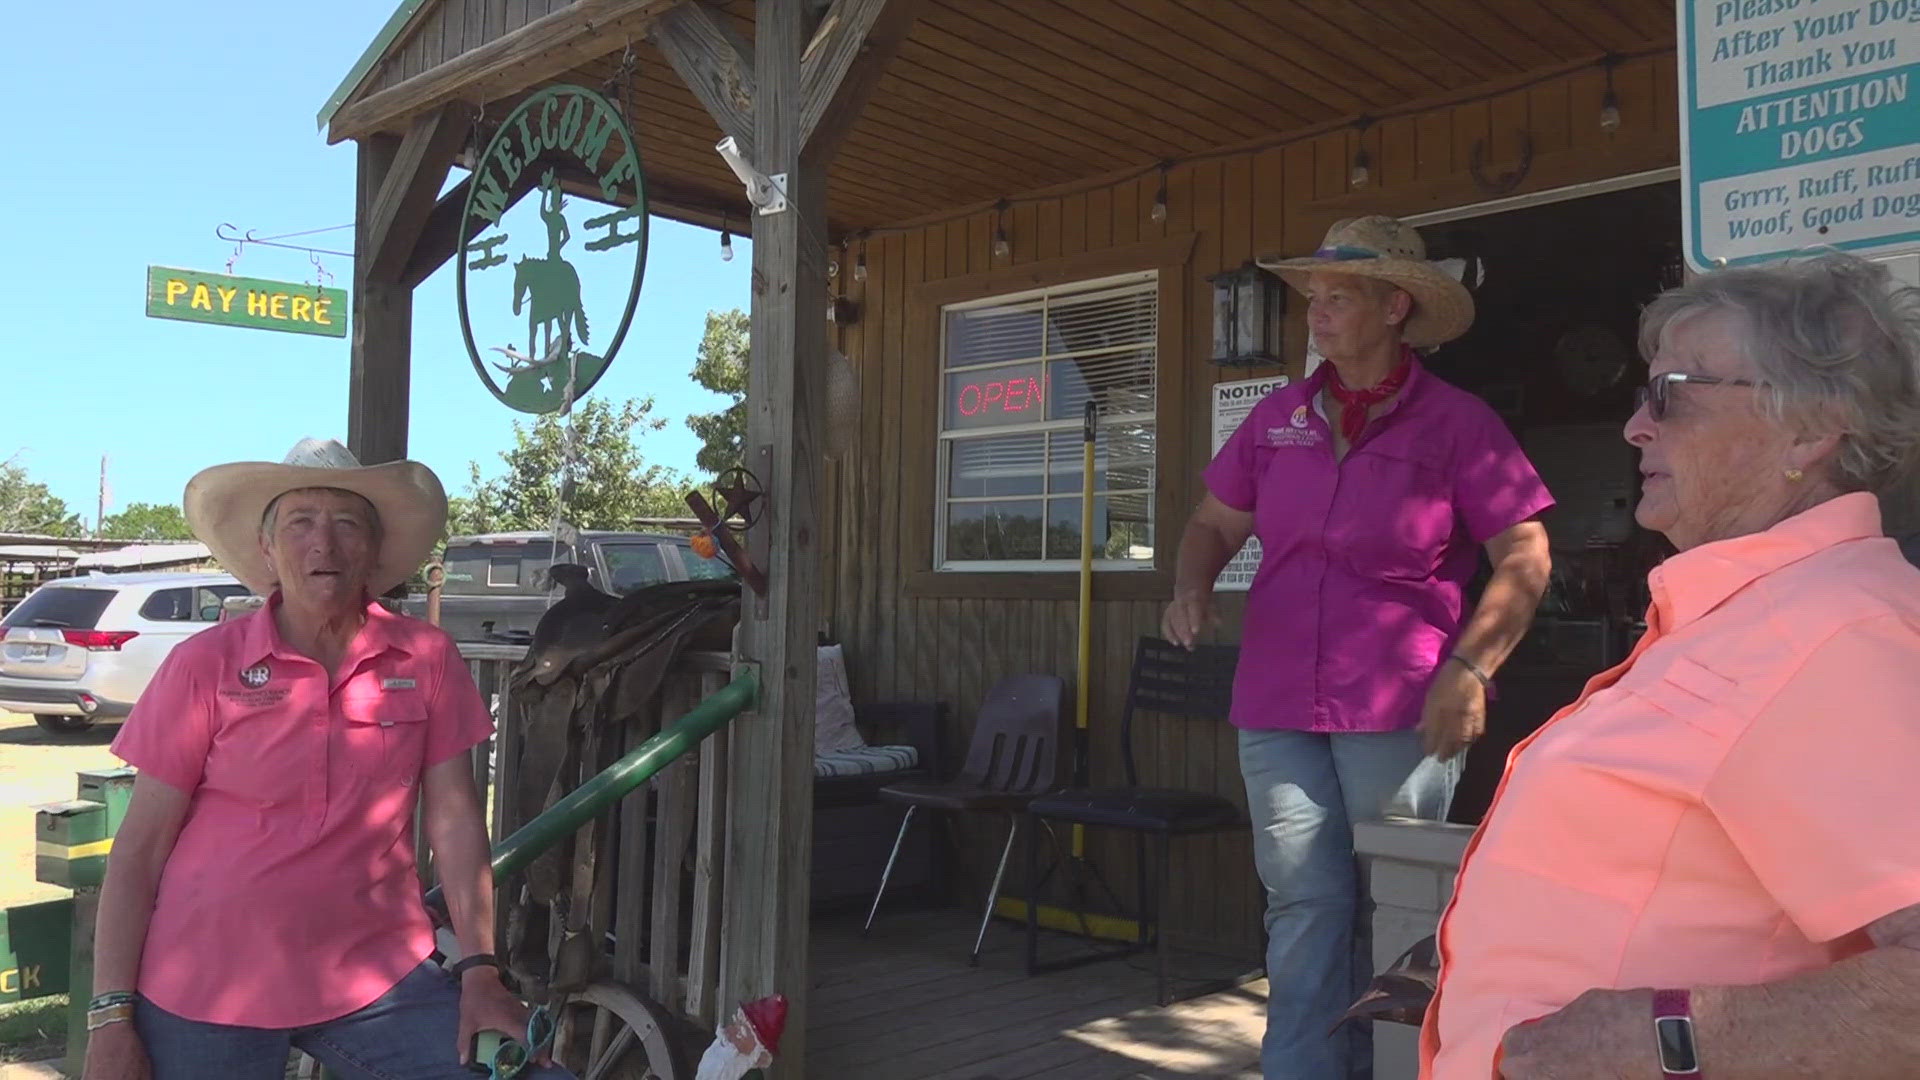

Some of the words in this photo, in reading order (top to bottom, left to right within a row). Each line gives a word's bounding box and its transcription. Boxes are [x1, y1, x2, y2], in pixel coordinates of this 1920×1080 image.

[1711, 26, 1786, 62] After
[1793, 8, 1861, 43] Your
[1743, 48, 1832, 90] Thank
[1841, 38, 1896, 68] You
[1735, 73, 1908, 134] ATTENTION
[469, 93, 636, 228] WELCOME
[1780, 117, 1865, 160] DOGS
[1724, 184, 1790, 212] Grrrr,
[1798, 168, 1859, 200] Ruff,
[1727, 209, 1793, 240] Woof,
[1802, 197, 1864, 228] Good
[165, 278, 238, 313] PAY
[247, 289, 332, 325] HERE
[959, 374, 1051, 416] OPEN
